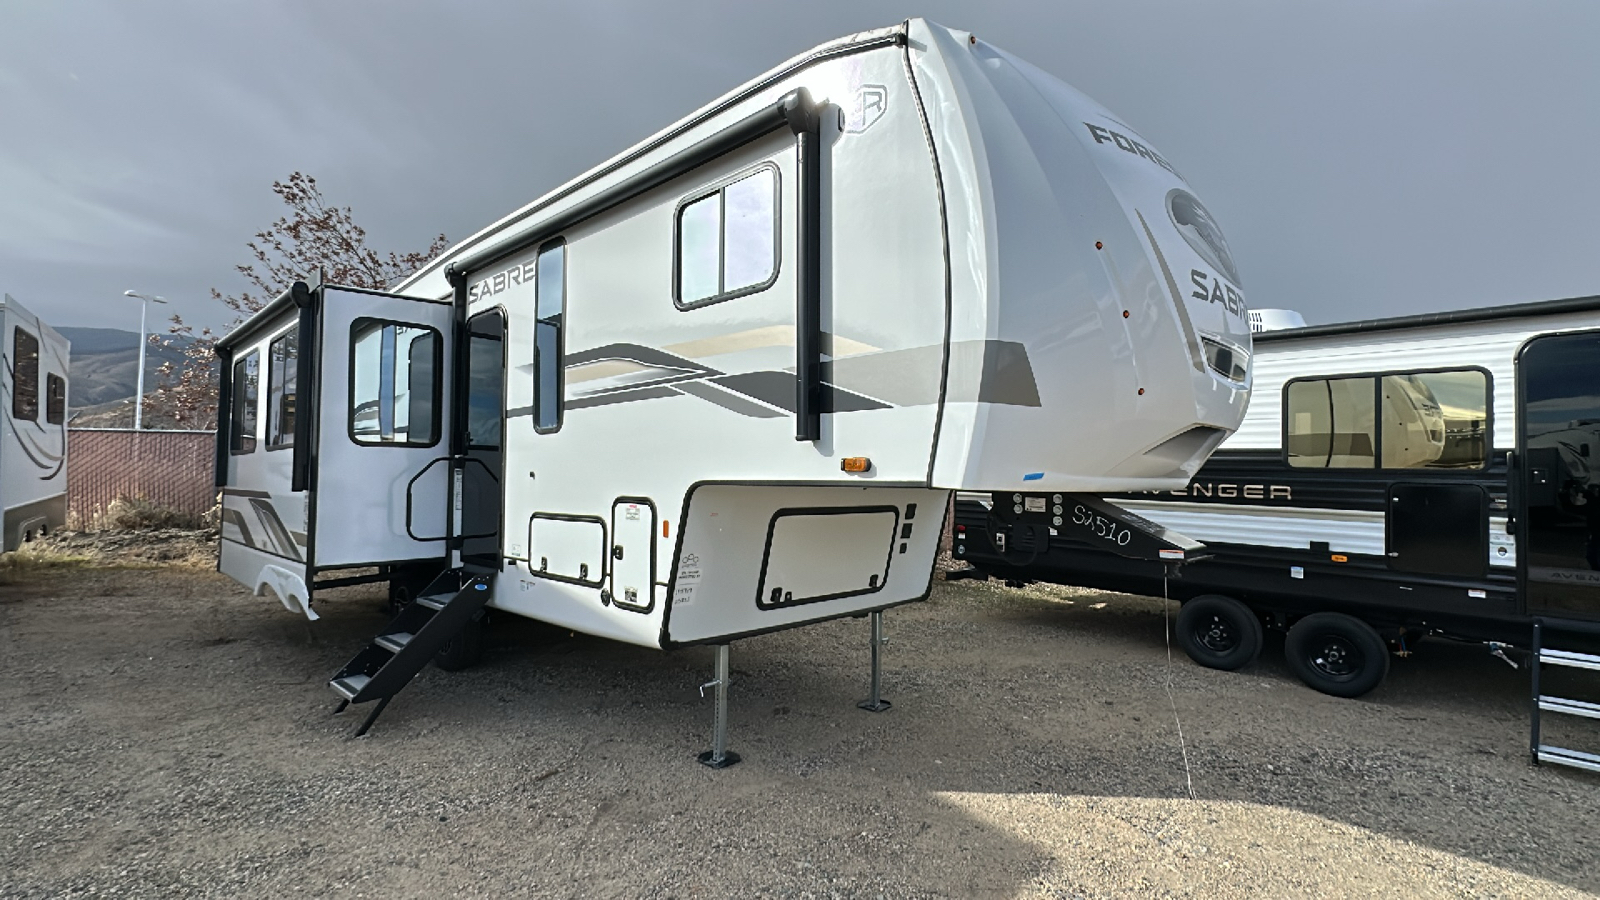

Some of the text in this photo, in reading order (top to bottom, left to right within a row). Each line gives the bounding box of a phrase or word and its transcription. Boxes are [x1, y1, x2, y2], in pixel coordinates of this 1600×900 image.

[1083, 121, 1182, 180] FORE
[468, 259, 536, 305] SABRE
[1191, 269, 1249, 324] SABR
[1072, 505, 1131, 546] S2510
[1551, 572, 1600, 582] AVEN
